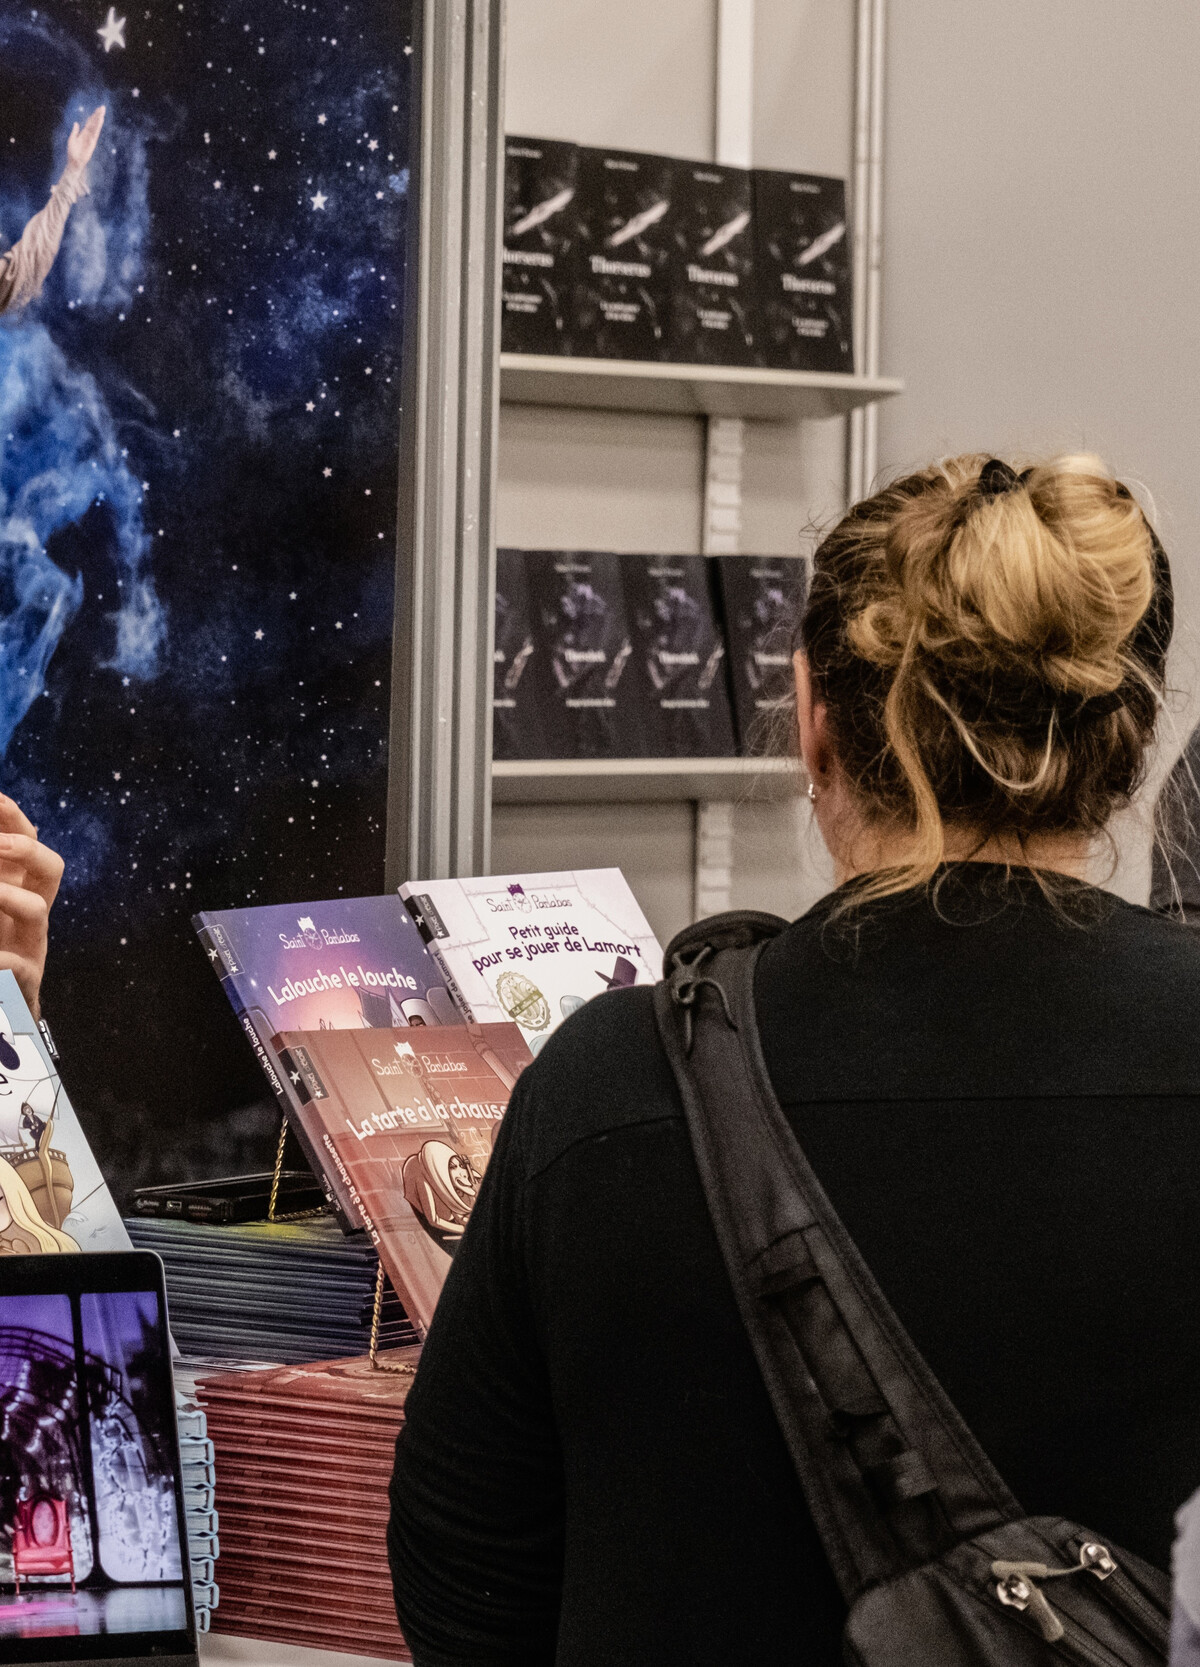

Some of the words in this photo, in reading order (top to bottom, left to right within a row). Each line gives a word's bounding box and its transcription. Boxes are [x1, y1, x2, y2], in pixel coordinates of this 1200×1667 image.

[486, 898, 514, 913] Saint
[531, 894, 573, 909] Parlabas
[278, 933, 306, 950] Saint
[320, 928, 360, 946] Parlabas
[508, 924, 542, 940] Petit
[544, 922, 579, 940] guide
[434, 952, 452, 982] Lamort
[472, 951, 503, 976] pour
[505, 945, 523, 960] se
[521, 940, 560, 961] jouer
[564, 936, 582, 952] de
[582, 936, 641, 957] Lamort
[267, 969, 343, 1006] Lalouche
[339, 966, 360, 987] le
[357, 965, 417, 991] louche
[449, 982, 458, 993] de
[455, 993, 471, 1015] jouer
[242, 1017, 260, 1047] louche
[255, 1046, 265, 1056] le
[260, 1055, 284, 1095] Lalouche
[372, 1058, 404, 1076] Saint
[421, 1055, 468, 1073] Parlabas
[346, 1118, 376, 1141] La
[371, 1105, 418, 1131] tarte
[414, 1098, 432, 1121] à
[426, 1097, 449, 1119] la
[321, 1134, 352, 1186] chaussette
[347, 1186, 357, 1197] la
[357, 1204, 373, 1229] tarte
[369, 1230, 381, 1245] La
